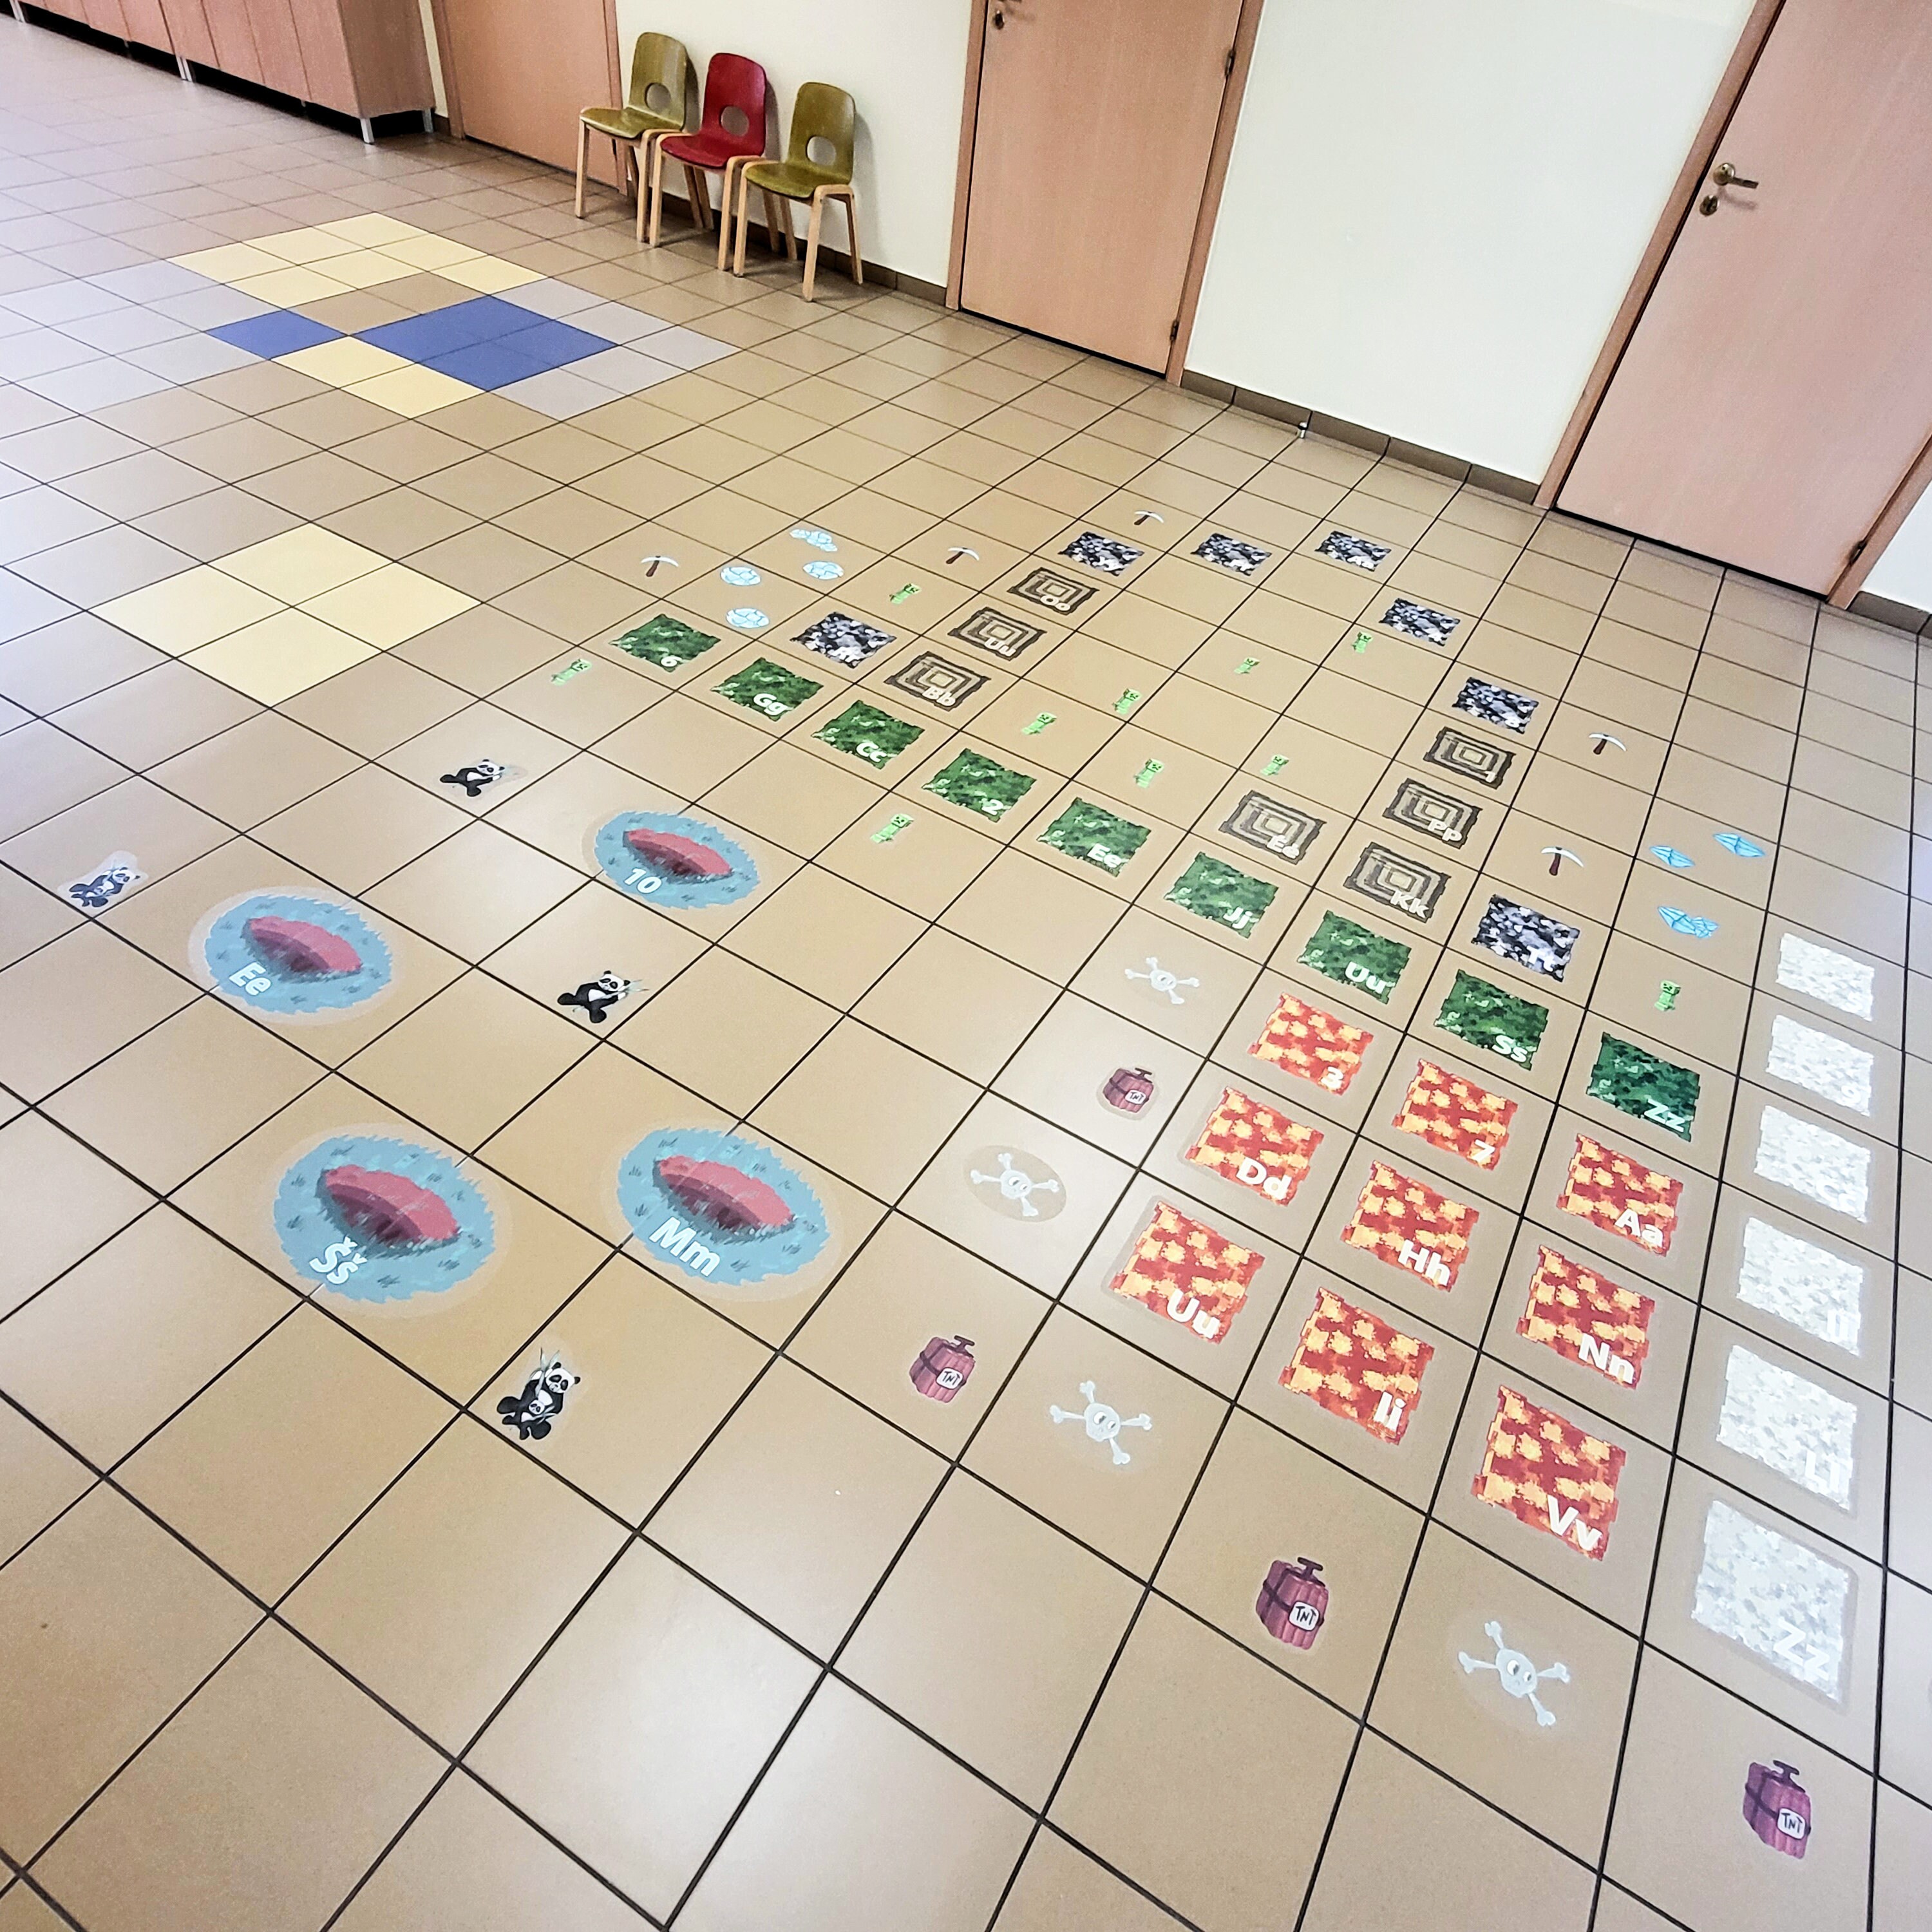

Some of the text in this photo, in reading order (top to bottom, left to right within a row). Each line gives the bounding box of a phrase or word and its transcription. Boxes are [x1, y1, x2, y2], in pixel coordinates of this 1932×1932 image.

[1040, 595, 1071, 611] Oo
[985, 637, 1016, 656] Uu
[661, 656, 681, 667] 6
[753, 693, 788, 715] Gg
[922, 686, 956, 706] Bb
[856, 742, 887, 762] Cc
[1484, 770, 1495, 783] 1
[981, 799, 1004, 815] 2
[1427, 818, 1462, 842] Pp
[1086, 843, 1122, 868] Ee
[624, 868, 662, 893] 10
[1390, 889, 1428, 918] Kk
[1223, 907, 1253, 929] Jj
[1526, 945, 1555, 972] Tt
[229, 961, 271, 996] Ee
[1345, 961, 1387, 994] Uu
[1492, 1035, 1527, 1062] Ss
[1321, 1066, 1344, 1090] 3
[1130, 1092, 1144, 1101] TNT
[1841, 1085, 1861, 1103] 9
[1644, 1099, 1685, 1132] Zz
[1474, 1139, 1495, 1162] 7
[1236, 1157, 1292, 1199] Dd
[1615, 1208, 1663, 1248] Aa
[649, 1217, 721, 1276] Mm
[309, 1236, 368, 1285] Šš
[1397, 1239, 1451, 1286] Hh
[1167, 1288, 1220, 1339] Uu
[1578, 1332, 1635, 1384] Nn
[942, 1371, 961, 1384] TNT
[1373, 1391, 1406, 1432] Ii
[1547, 1495, 1602, 1551] Vv
[1296, 1605, 1316, 1626] TNT
[1773, 1618, 1830, 1681] Zz
[1782, 1812, 1804, 1834] TNT
